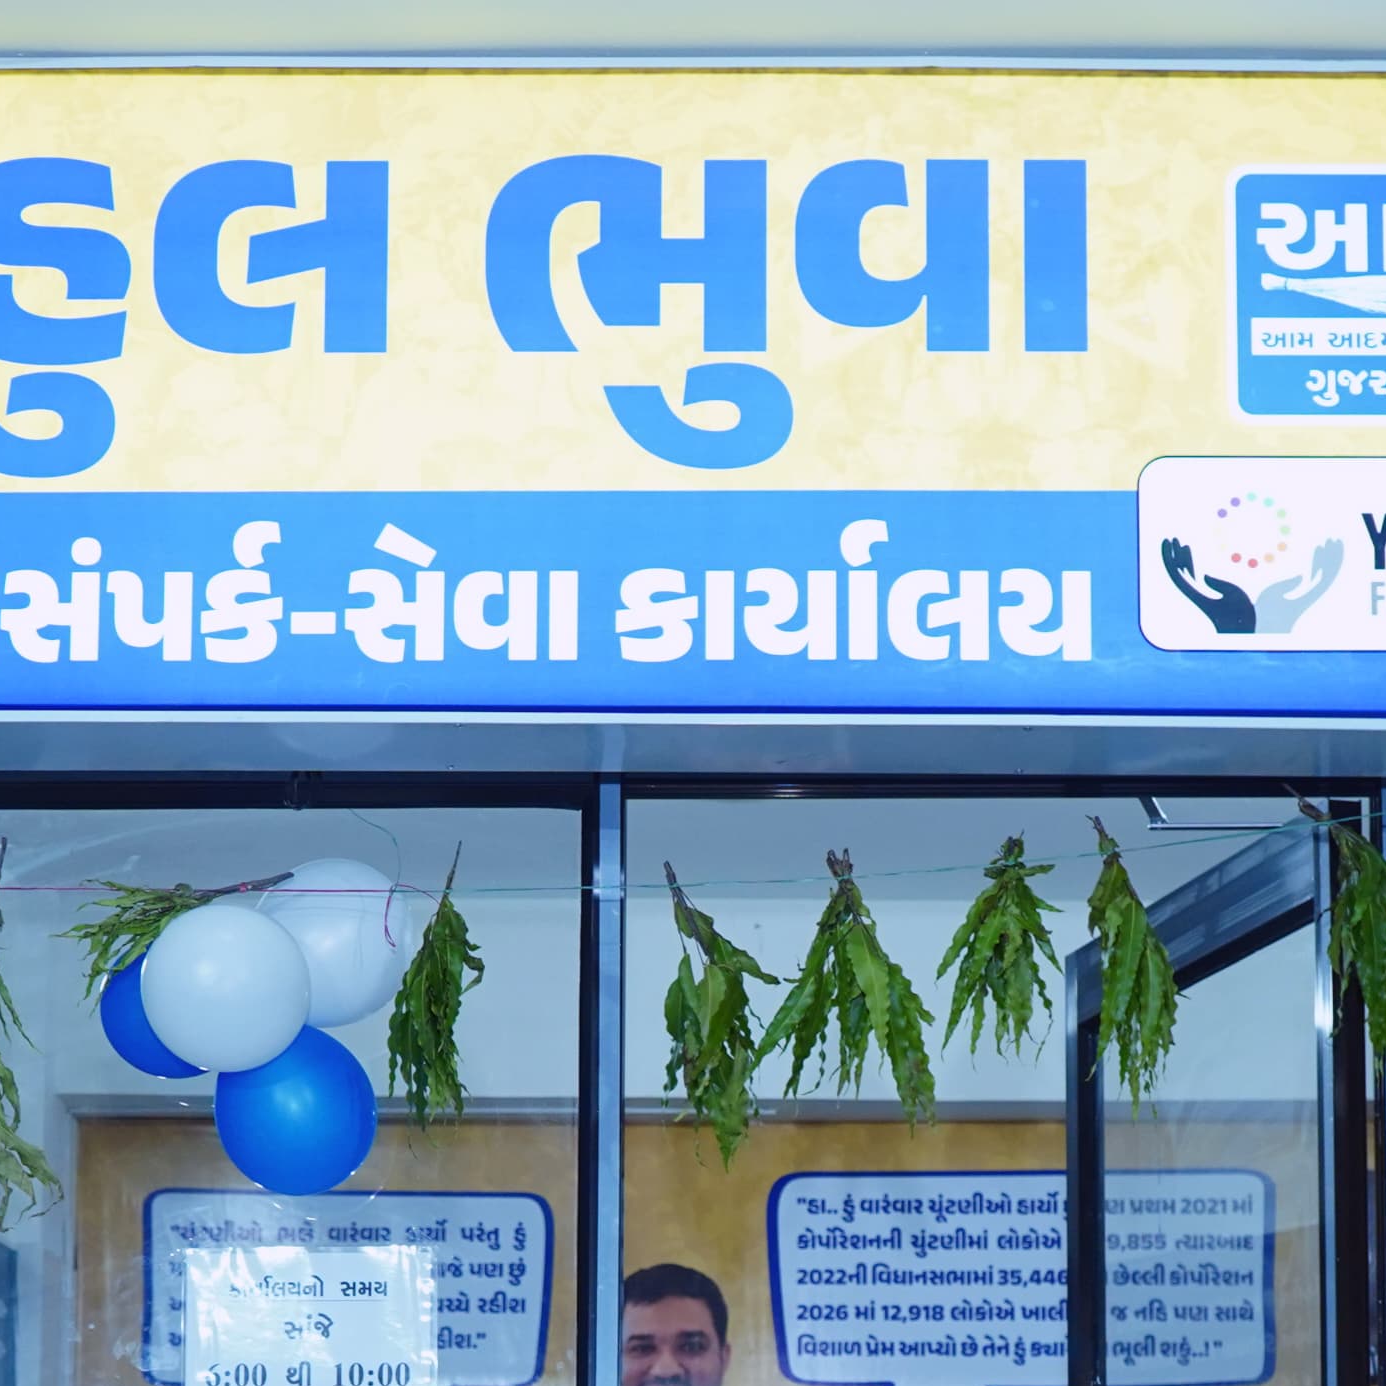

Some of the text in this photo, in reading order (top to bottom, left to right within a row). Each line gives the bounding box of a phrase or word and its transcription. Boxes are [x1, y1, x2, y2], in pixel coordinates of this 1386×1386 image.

[484, 154, 1088, 470] ભુવા
[1261, 331, 1313, 349] આમ
[616, 520, 1093, 662] કાર્યાલય
[860, 1193, 924, 1216] વારંવાર
[1180, 1198, 1227, 1215] 2021
[1231, 1194, 1253, 1215] માં
[328, 1220, 392, 1244] વારંવાર
[461, 1221, 501, 1250] પરંતુ
[469, 1262, 503, 1278] પણ
[797, 1262, 867, 1285] 2022ની
[340, 1280, 388, 1297] સમય
[797, 1304, 849, 1321] 2026
[855, 1300, 875, 1321] માં
[882, 1304, 945, 1323] 12,918
